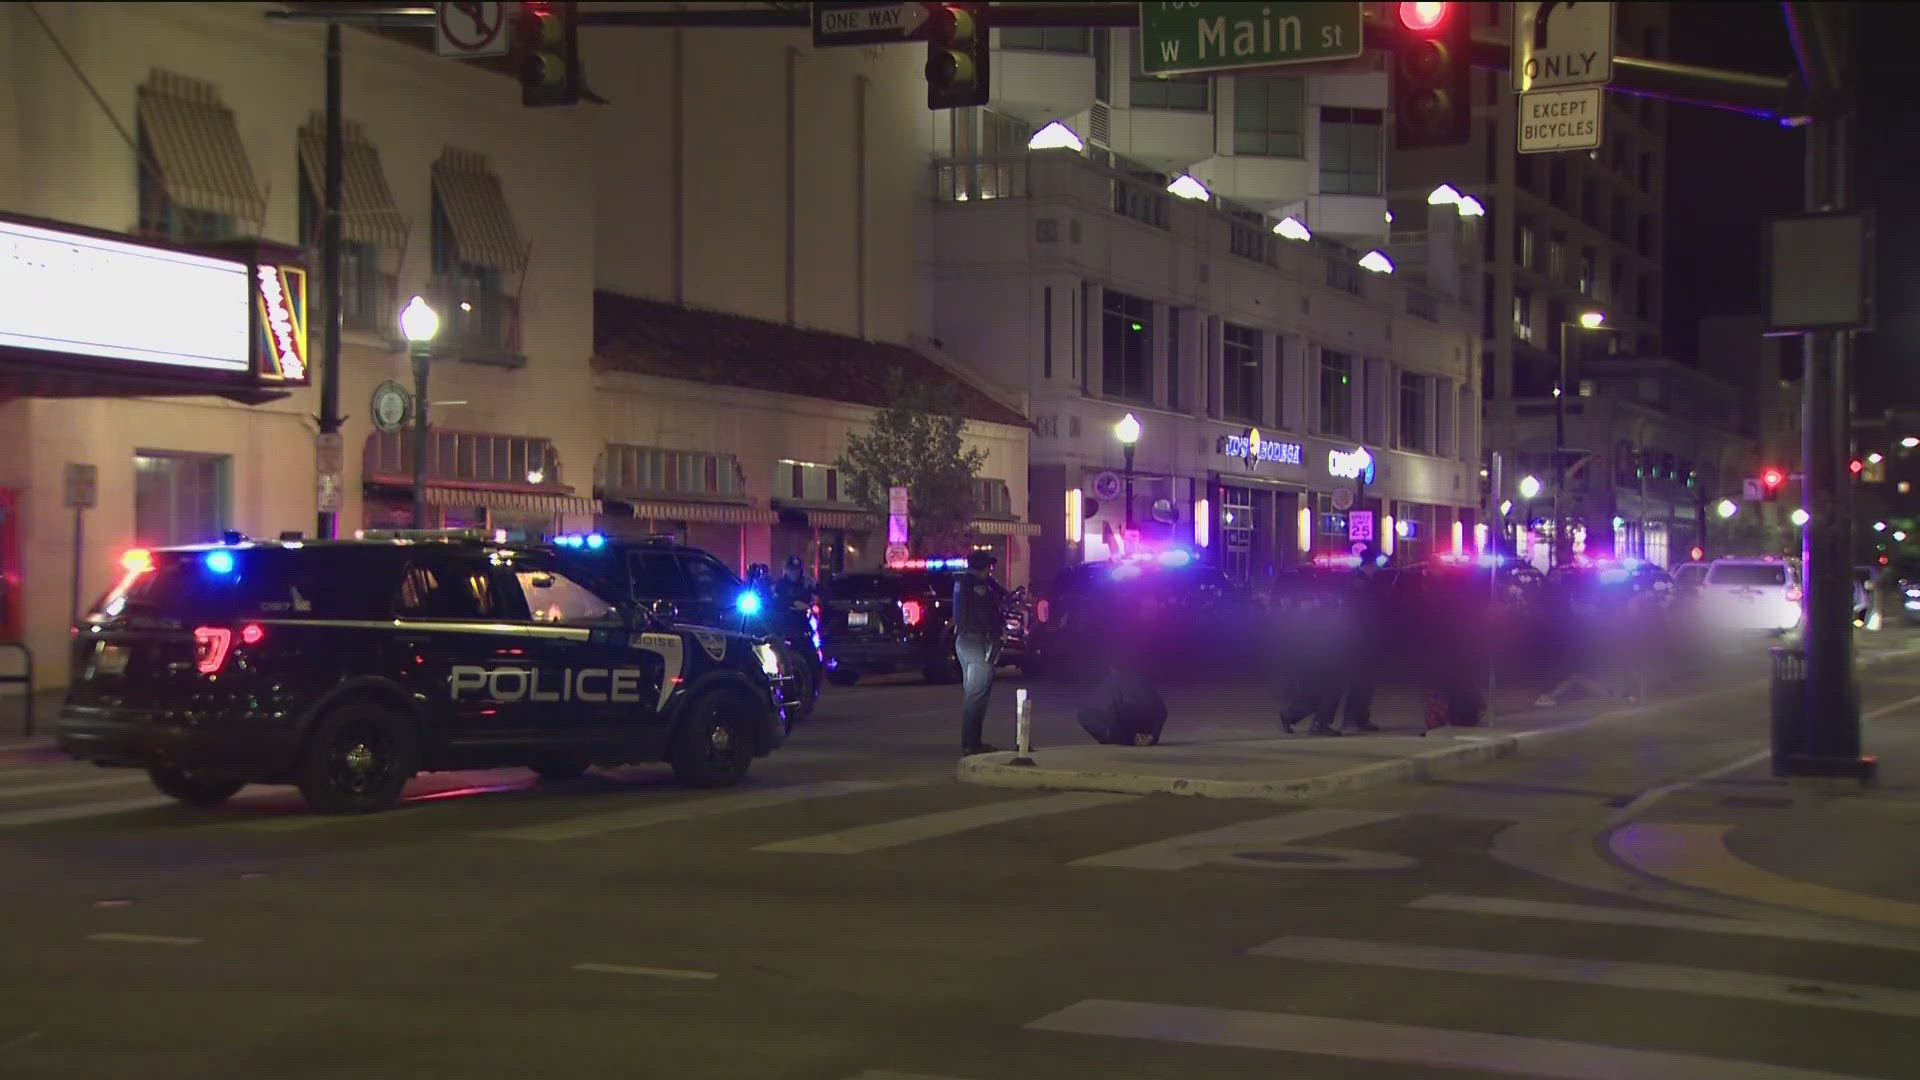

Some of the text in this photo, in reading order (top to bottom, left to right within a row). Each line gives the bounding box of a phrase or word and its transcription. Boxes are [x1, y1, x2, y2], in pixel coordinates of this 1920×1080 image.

[826, 8, 902, 30] ONE WAY
[1160, 6, 1343, 63] W Main St
[1524, 51, 1597, 80] ONLY
[1533, 101, 1587, 119] EXCEPT
[1525, 121, 1594, 140] BICYCLES
[1257, 441, 1300, 464] BODEGA
[1352, 525, 1370, 537] 25
[451, 665, 641, 702] POLICE
